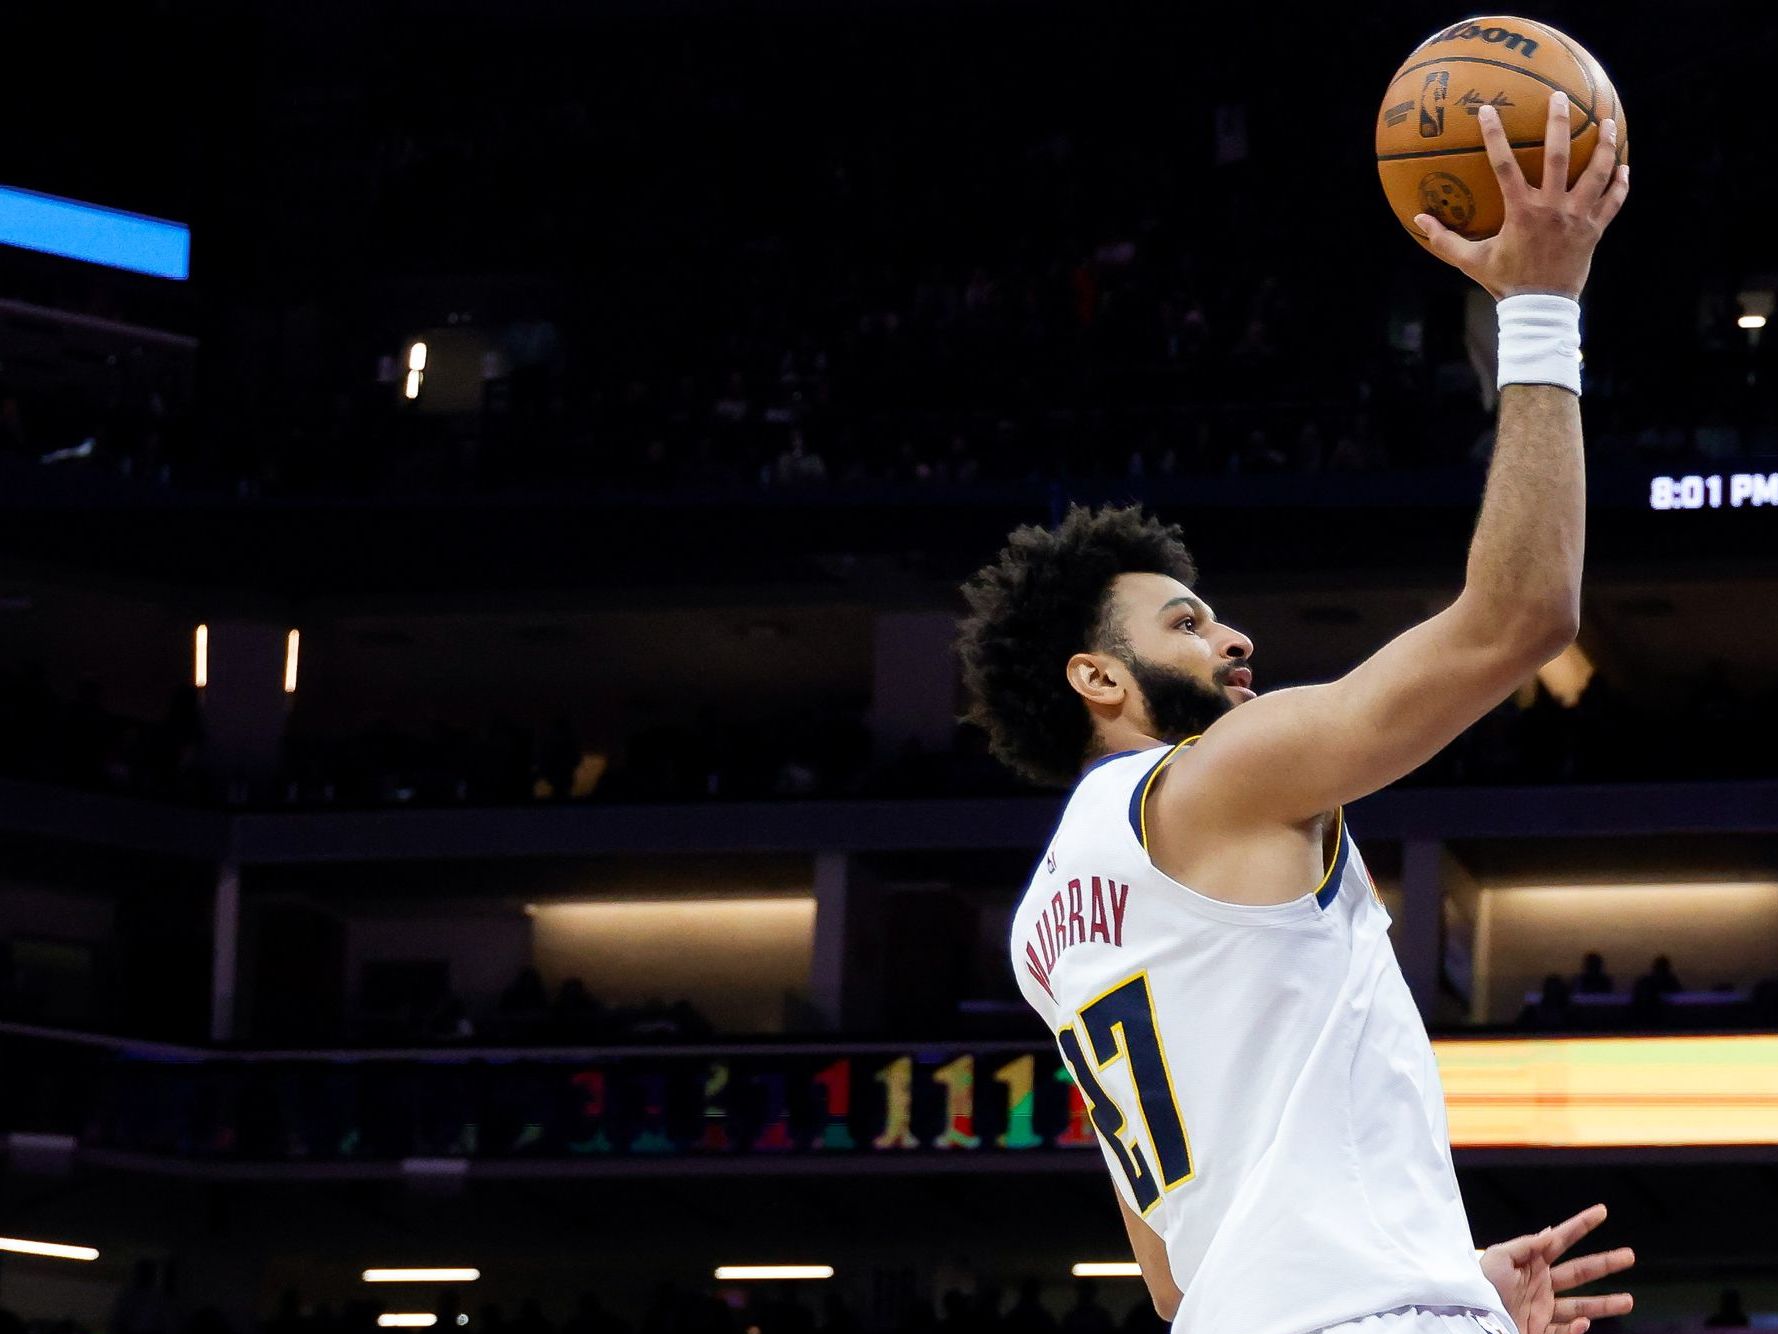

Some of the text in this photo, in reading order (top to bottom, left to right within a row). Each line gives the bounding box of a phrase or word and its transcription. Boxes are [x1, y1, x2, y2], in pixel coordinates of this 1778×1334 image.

[1650, 475, 1722, 510] 8:01
[1025, 876, 1129, 1006] MURRAY
[1057, 968, 1195, 1219] 27
